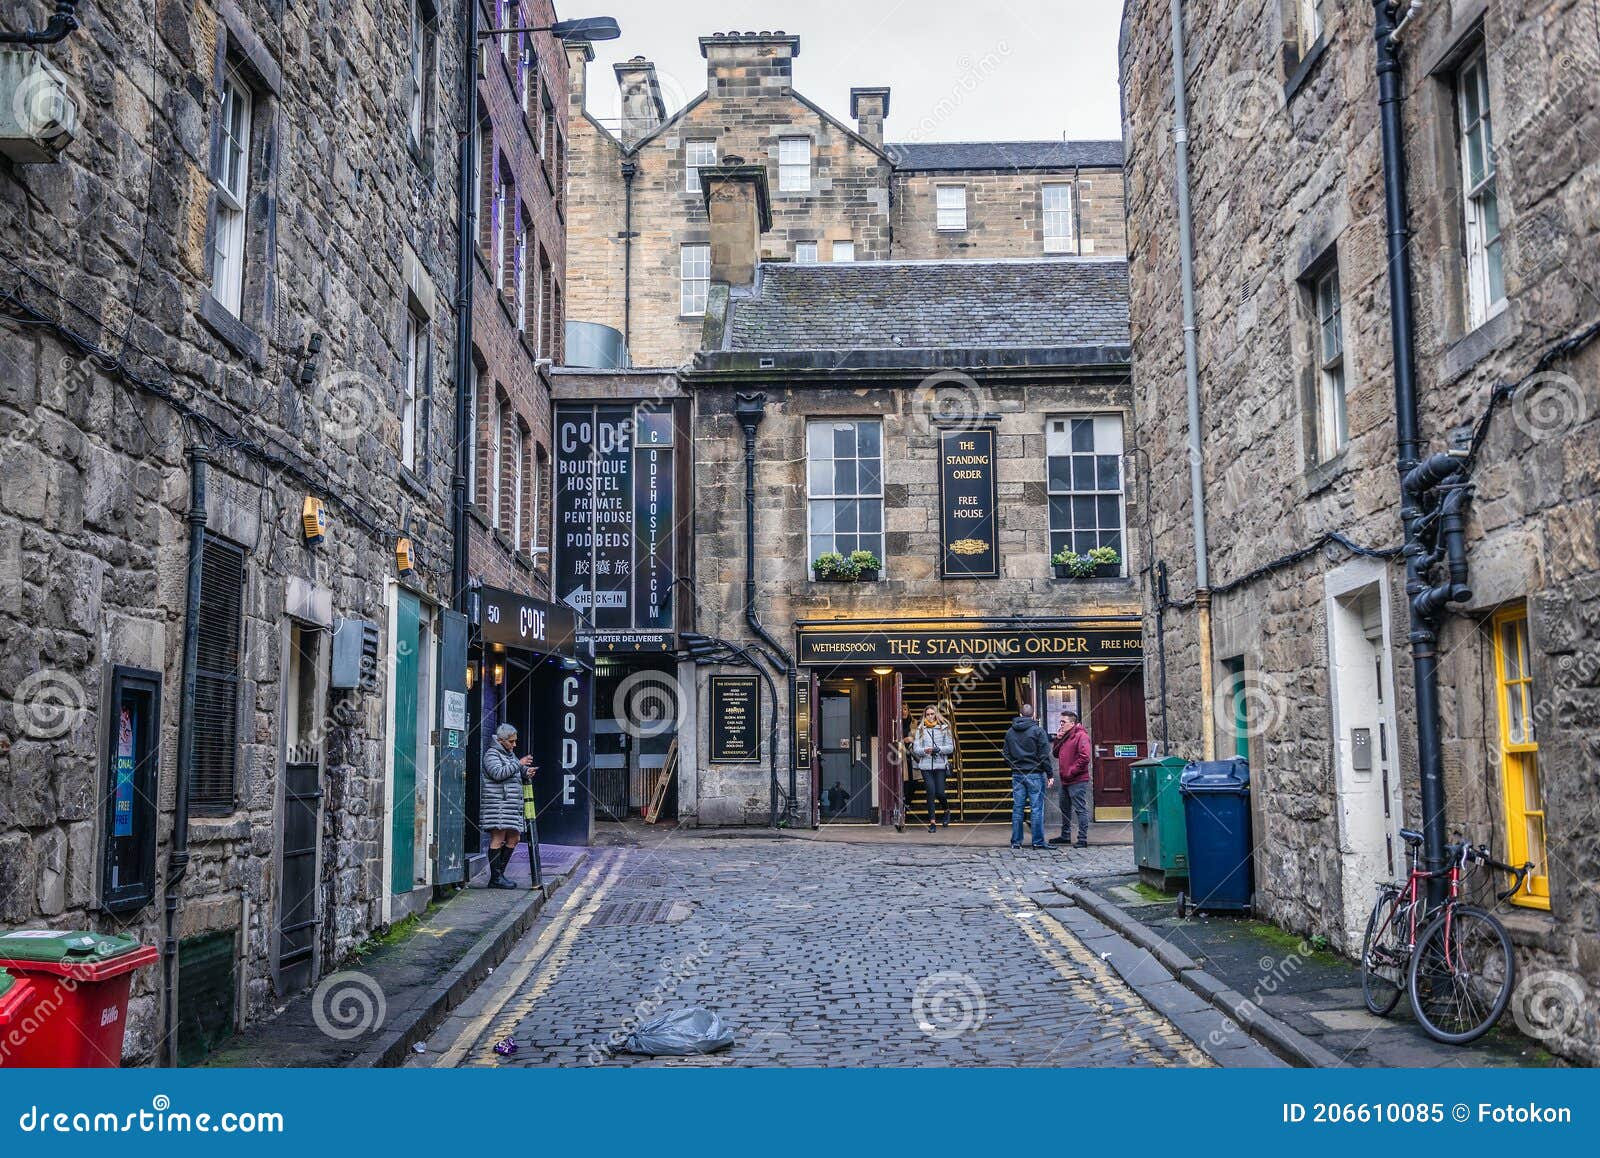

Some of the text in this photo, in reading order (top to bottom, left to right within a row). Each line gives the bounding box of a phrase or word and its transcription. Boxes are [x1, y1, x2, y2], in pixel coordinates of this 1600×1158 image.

[959, 441, 975, 451] THE
[946, 455, 989, 465] STANDING
[559, 460, 627, 475] BOUTIQUE
[953, 470, 982, 479] ORDER
[567, 476, 619, 491] HOSTEL
[574, 497, 622, 510] PRIVATE
[958, 496, 979, 505] FREE
[953, 509, 984, 518] HOUSE
[574, 594, 623, 604] CHECK-IN
[487, 605, 500, 624] 50
[622, 635, 663, 643] DELIVERIES
[811, 642, 876, 652] WETHERSPOON
[887, 639, 921, 655] THE
[926, 638, 1021, 655] STANDING
[1025, 637, 1090, 653] ORDER
[1101, 639, 1122, 649] FREE
